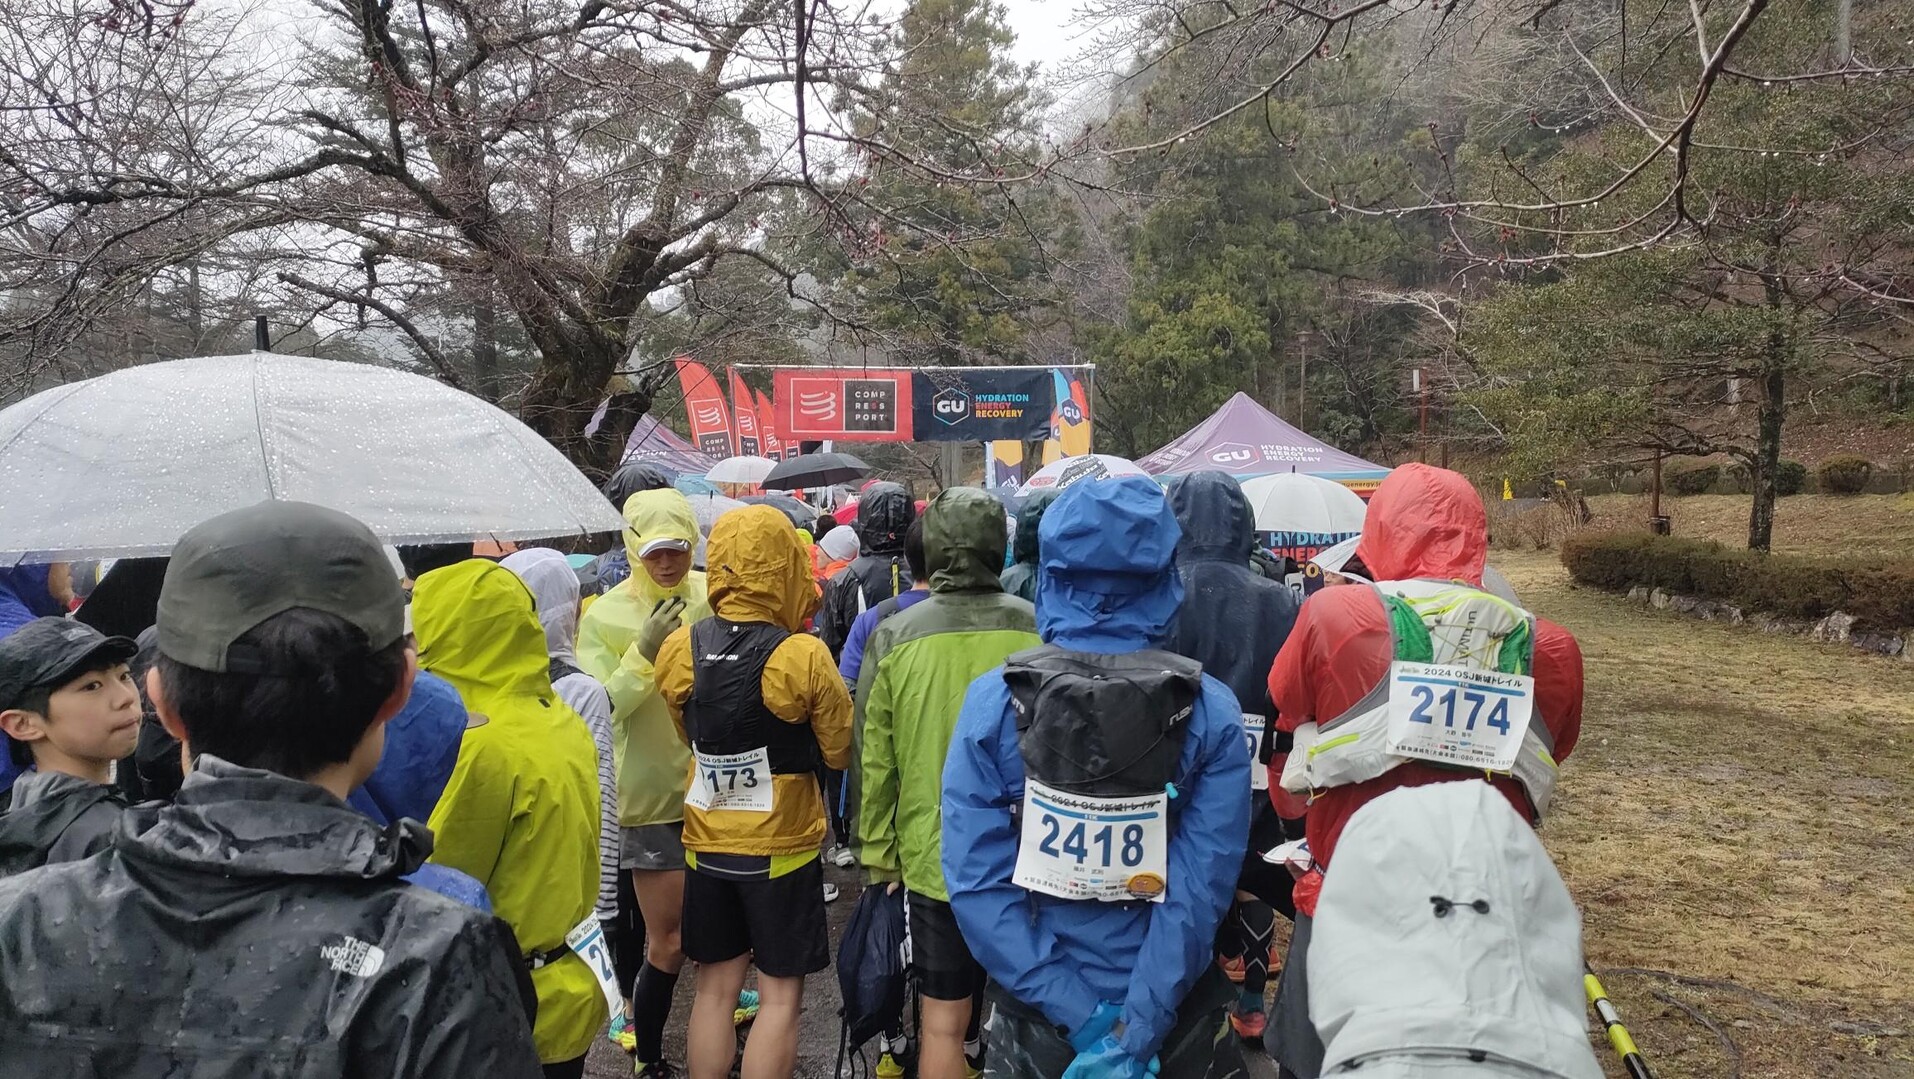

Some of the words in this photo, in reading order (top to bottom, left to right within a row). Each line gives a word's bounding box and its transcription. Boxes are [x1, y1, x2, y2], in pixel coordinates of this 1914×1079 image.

[976, 394, 1029, 402] HYDRATION
[855, 402, 885, 410] RESS
[937, 400, 965, 413] GU
[976, 402, 1011, 410] ENERGY
[1064, 406, 1081, 419] GU
[976, 409, 1023, 418] RECOVERY
[1212, 449, 1251, 462] GU
[1261, 445, 1323, 453] HYDRATION
[1424, 667, 1452, 678] 2024
[1455, 670, 1523, 688] OSJ新城トレイル
[1409, 685, 1511, 736] 2174
[1039, 813, 1144, 868] 2418
[344, 935, 371, 953] THE
[320, 945, 366, 966] NORTH
[330, 958, 359, 976] FACE
